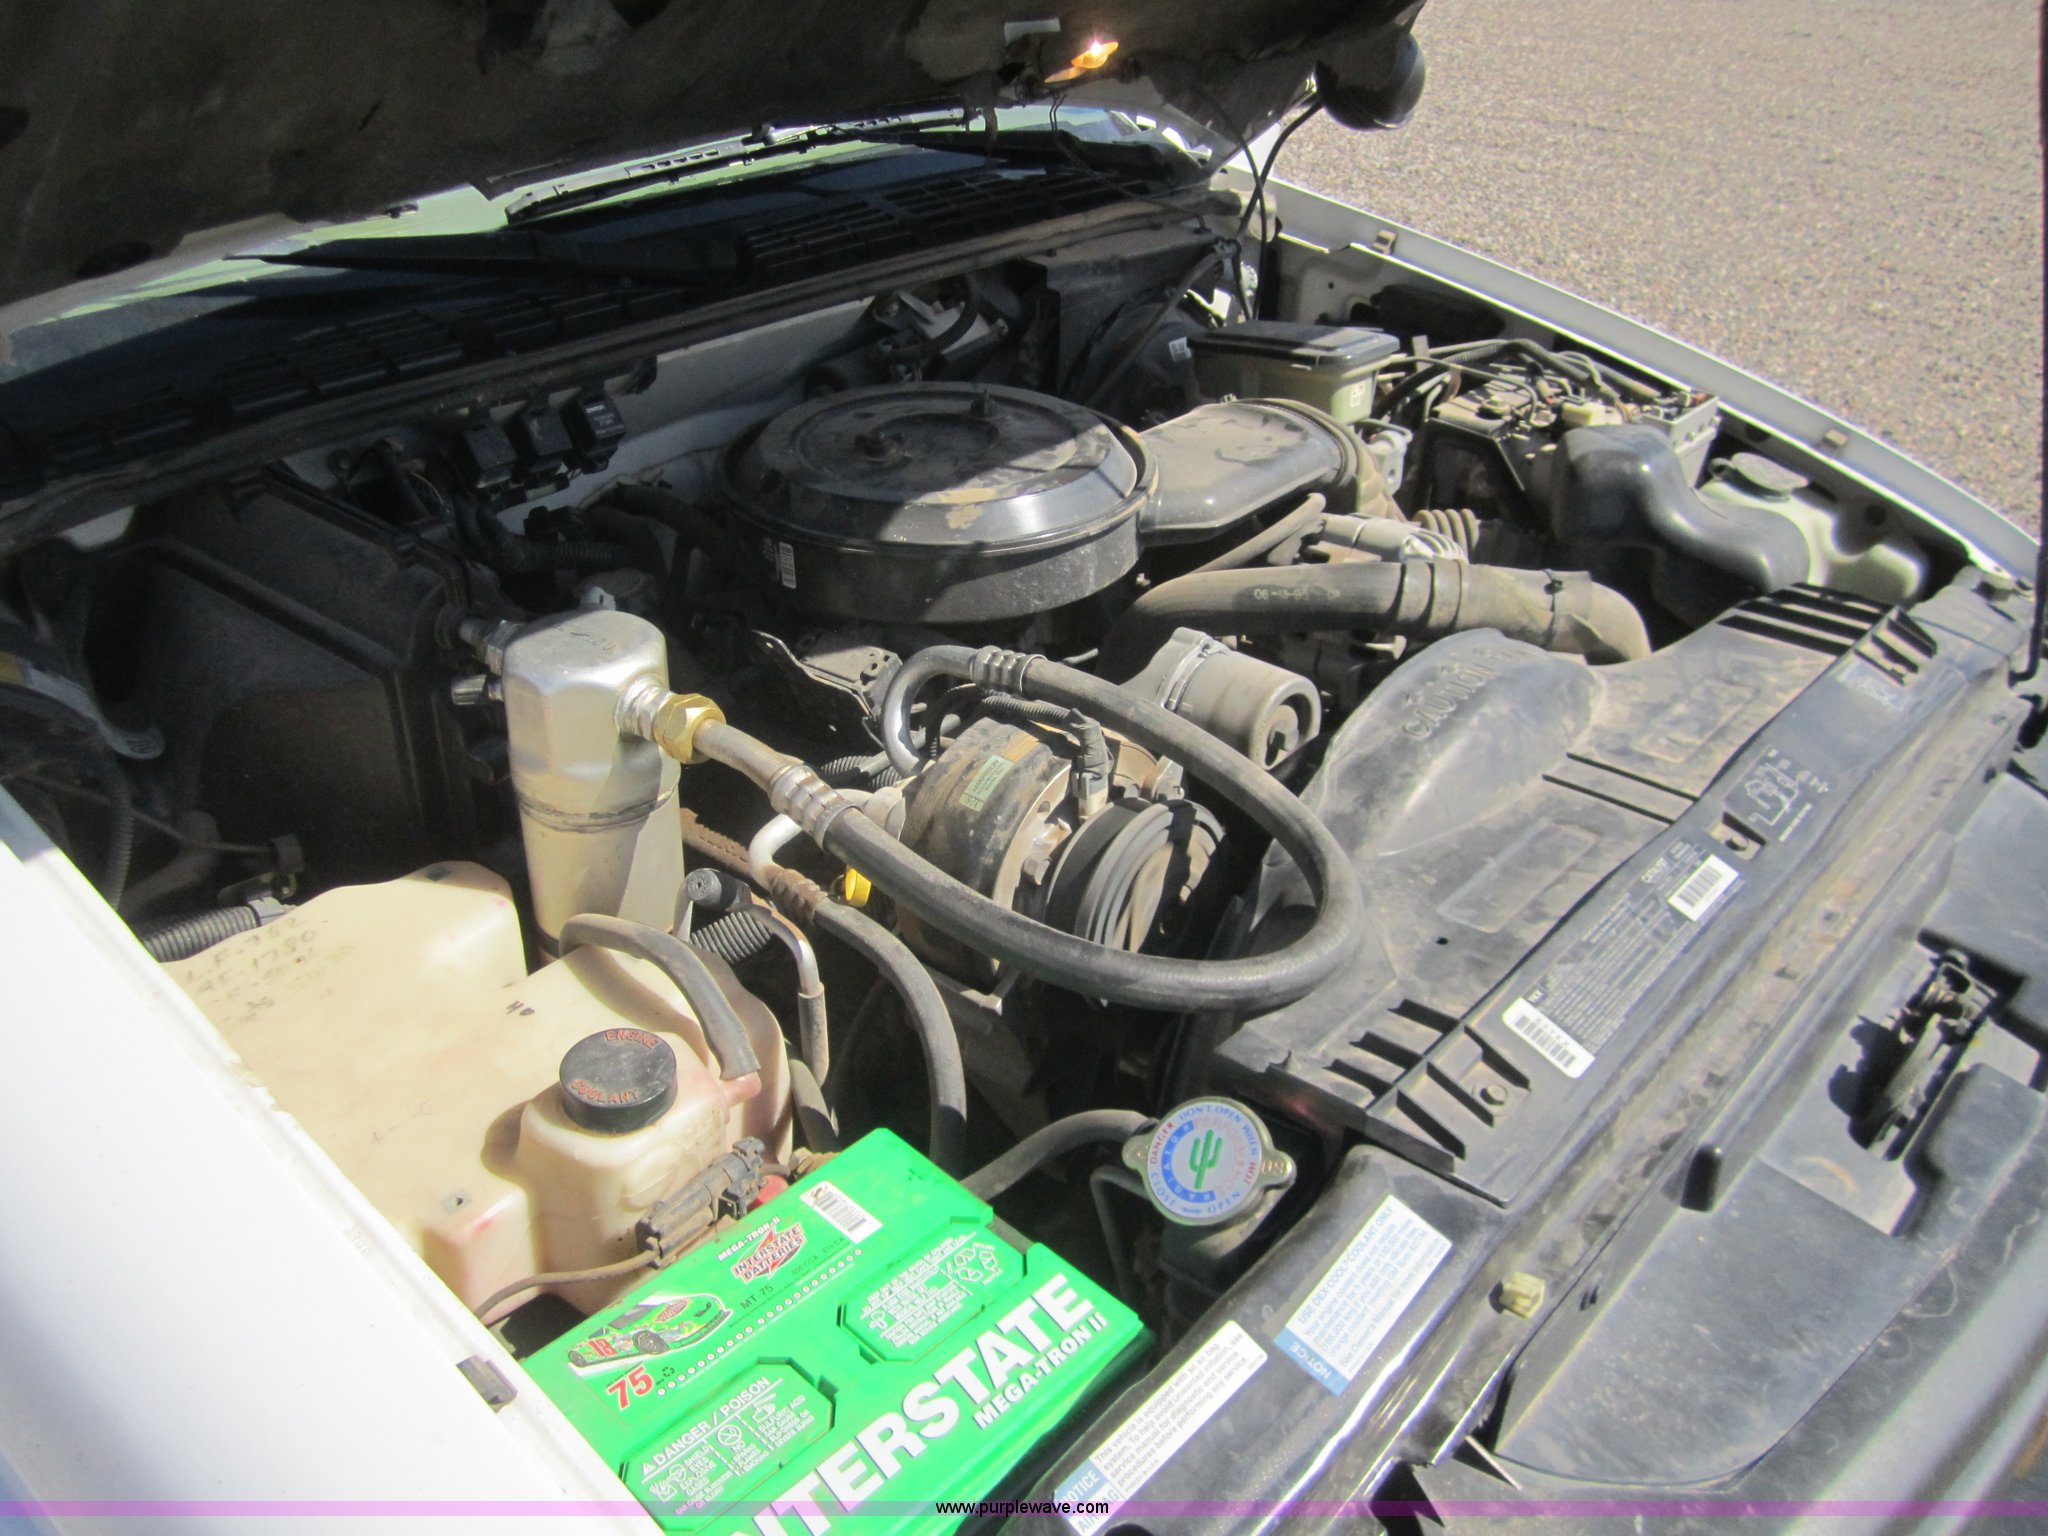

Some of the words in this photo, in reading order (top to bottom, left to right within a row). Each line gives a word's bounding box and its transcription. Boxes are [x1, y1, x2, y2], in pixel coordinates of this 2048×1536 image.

[604, 1029, 658, 1049] ENGINE
[1215, 1104, 1243, 1123] OPEN
[1151, 1121, 1175, 1164] DANGER
[1242, 1124, 1259, 1156] WHEN
[1243, 1162, 1257, 1185] HOT
[717, 1223, 773, 1262] MEGA-TRON
[734, 1226, 801, 1275] INTERSTATE
[744, 1237, 803, 1280] BATTERIES
[1297, 1303, 1315, 1323] USE
[1345, 1224, 1378, 1262] COOLANT
[1374, 1205, 1393, 1227] ONLY
[972, 1325, 1092, 1430] MEGA-TRON
[1087, 1312, 1108, 1332] II
[1290, 1342, 1332, 1381] NOTICE
[606, 1364, 655, 1411] 75
[652, 1420, 712, 1467] DANGER
[720, 1376, 771, 1418] POISON
[1094, 1445, 1113, 1463] This
[1110, 1421, 1137, 1448] vehicle
[1141, 1384, 1175, 1418] equipped
[1128, 1432, 1140, 1444] To
[1137, 1417, 1156, 1437] help
[1152, 1399, 1174, 1421] avoid
[731, 1439, 746, 1452] NO
[1109, 1452, 1136, 1478] service
[1134, 1427, 1160, 1454] manual
[1116, 1446, 1158, 1487] procedures
[1153, 1424, 1178, 1448] before
